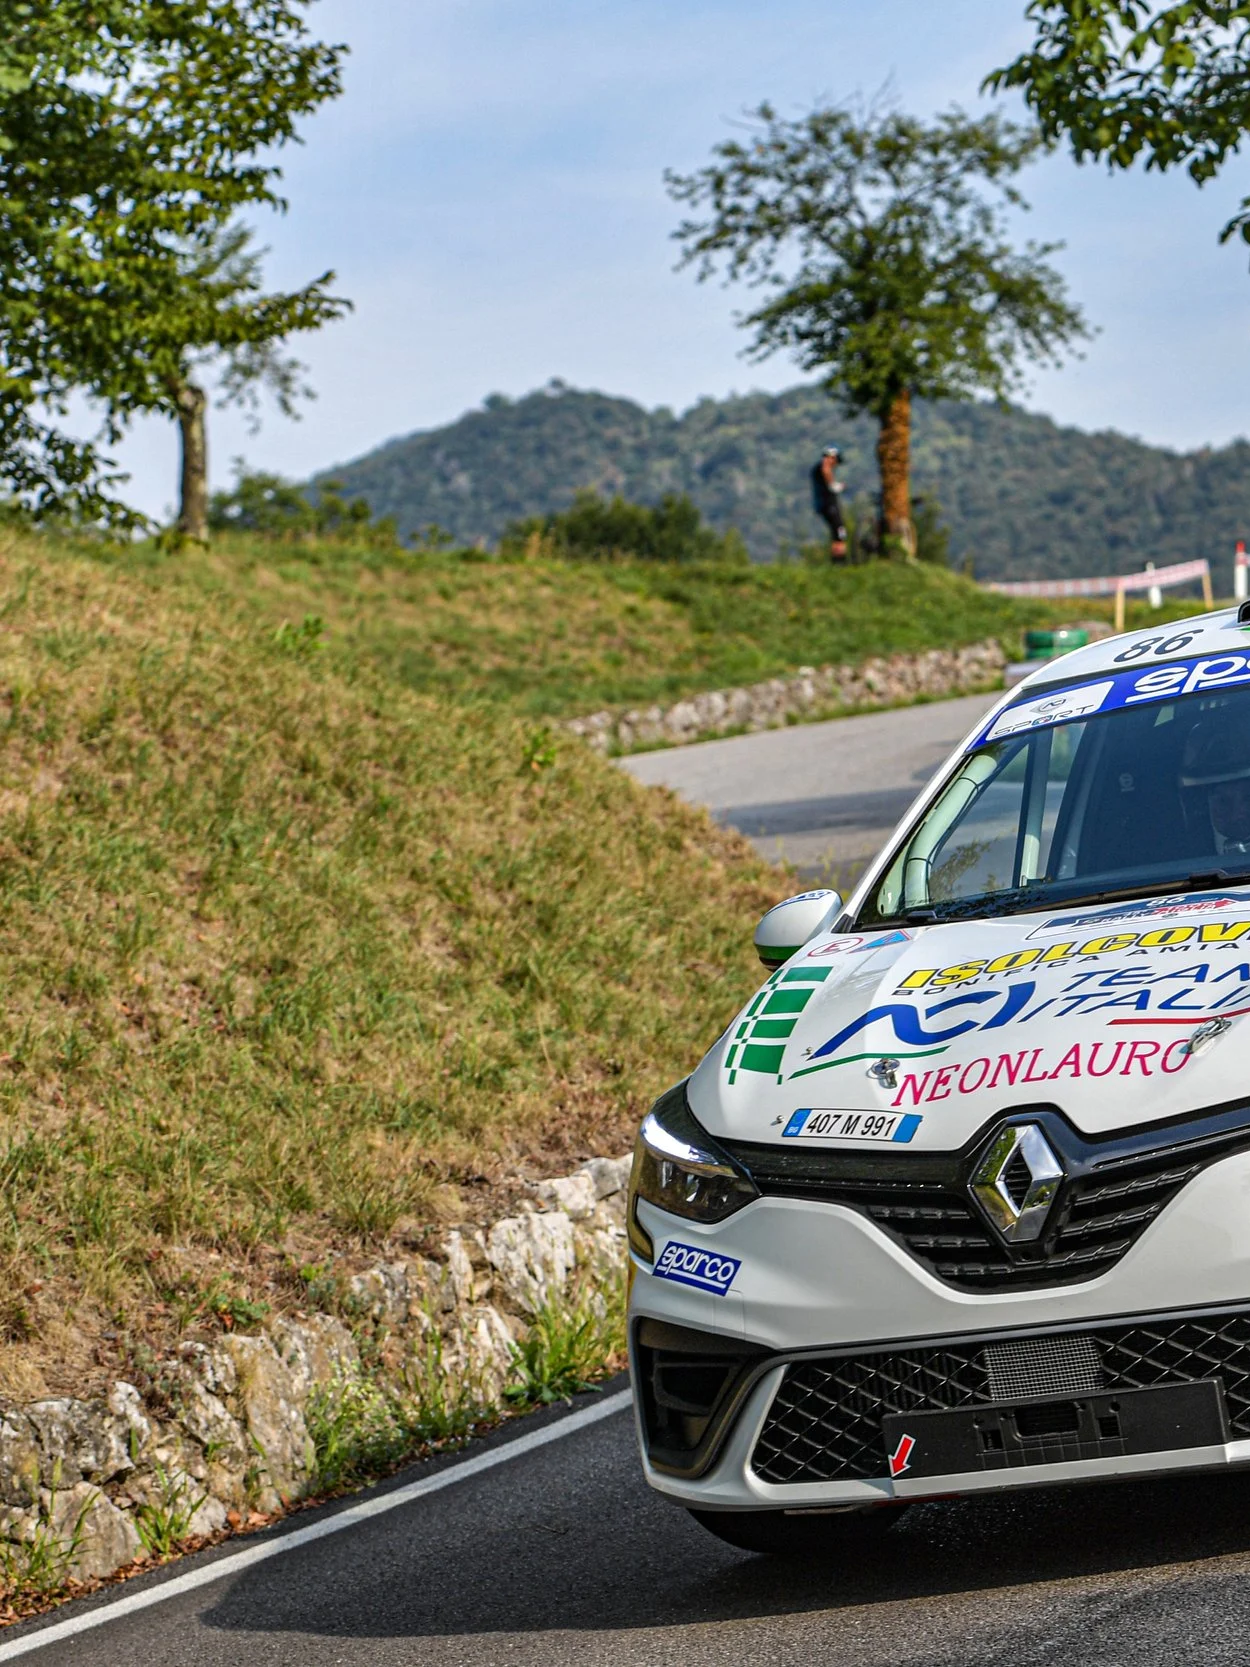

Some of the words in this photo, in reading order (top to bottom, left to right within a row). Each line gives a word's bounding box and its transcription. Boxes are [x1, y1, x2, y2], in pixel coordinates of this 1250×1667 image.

[1113, 629, 1204, 663] 86
[993, 704, 1094, 737] SPORT
[891, 955, 1100, 996] BONIFICA
[891, 1037, 1197, 1107] NEONLAURO
[806, 1113, 843, 1134] 407
[840, 1114, 862, 1135] M
[861, 1115, 898, 1137] 991
[659, 1245, 735, 1282] sparco
